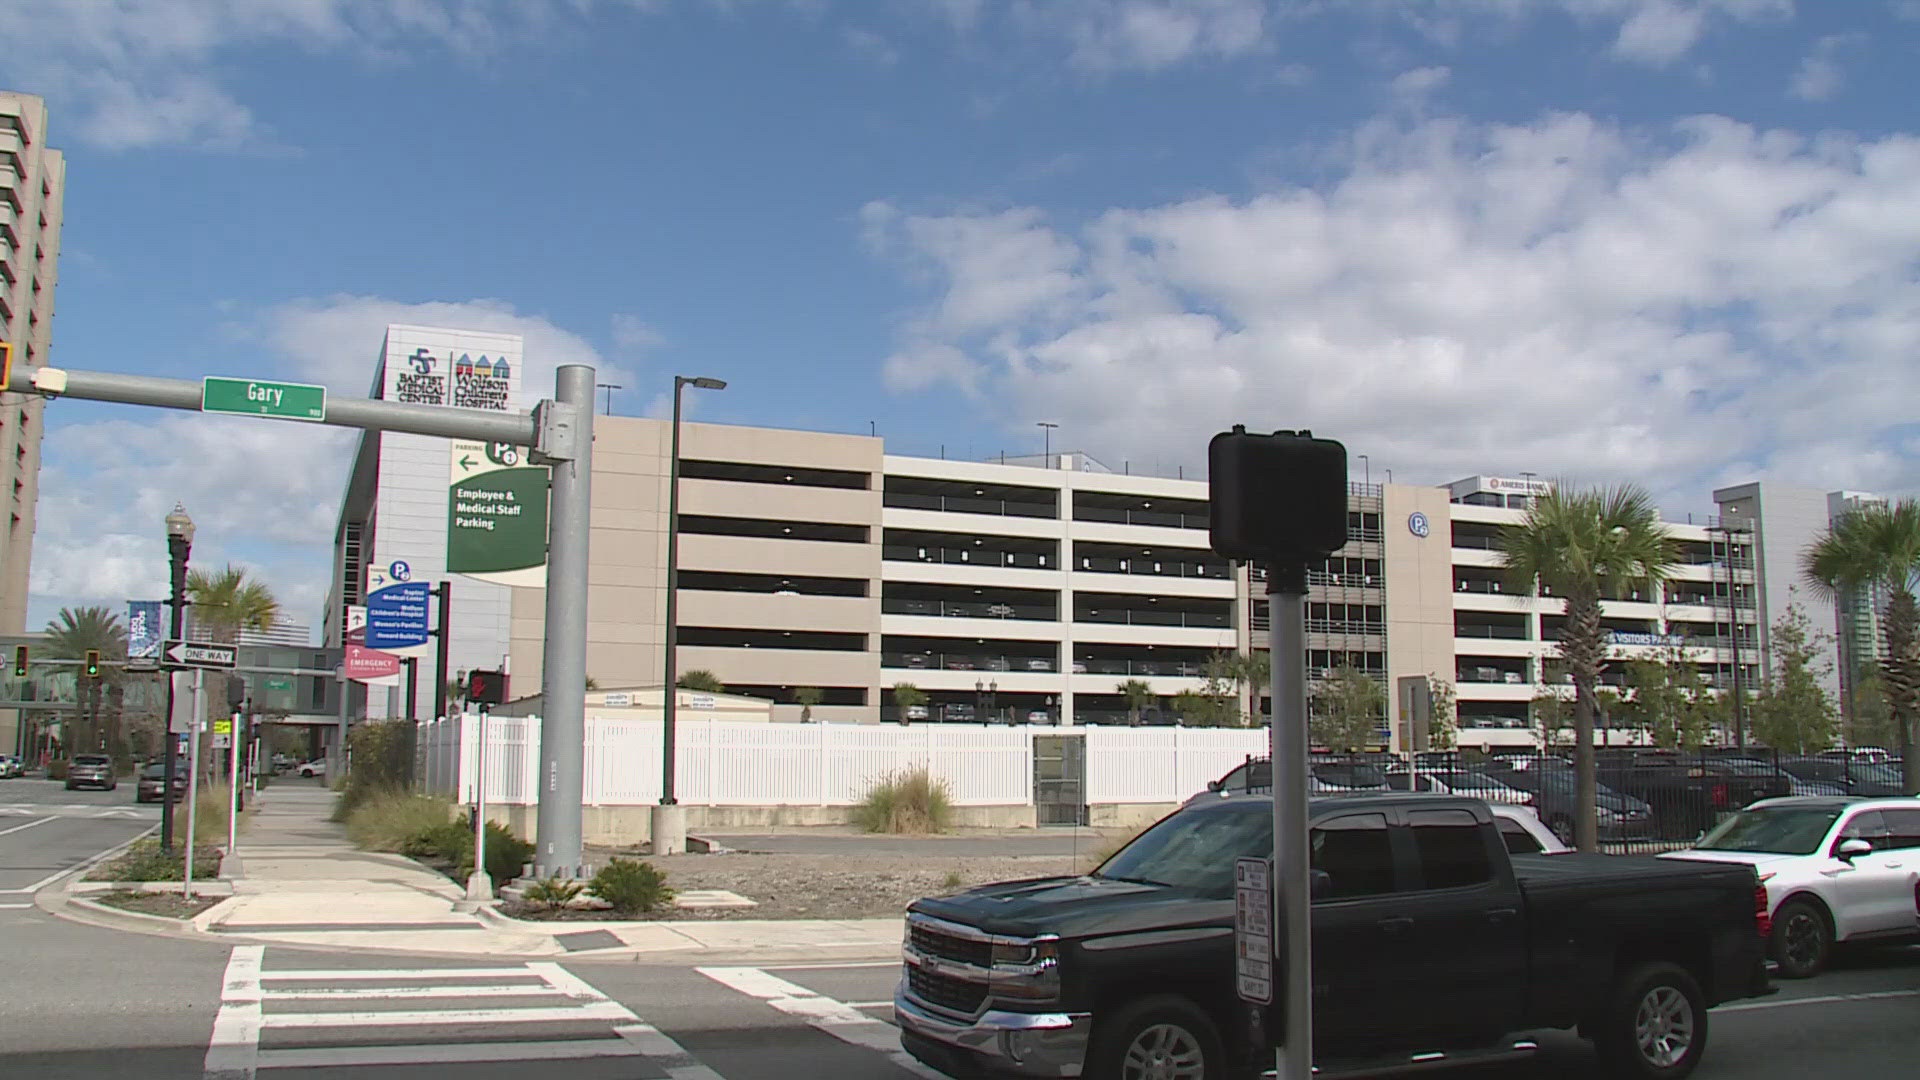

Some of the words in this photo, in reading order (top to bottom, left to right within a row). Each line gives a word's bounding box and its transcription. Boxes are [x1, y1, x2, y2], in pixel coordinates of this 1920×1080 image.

[399, 373, 445, 386] BAPTIST
[455, 373, 509, 390] Wolfson
[247, 383, 283, 407] Gary
[396, 383, 446, 395] MEDICAL
[398, 393, 443, 405] CENTER
[454, 398, 507, 410] HOSPITAL
[457, 488, 505, 502] Employee
[506, 491, 514, 501] &
[457, 503, 495, 514] Medical
[497, 505, 521, 515] Staff
[456, 518, 494, 530] Parking
[1616, 633, 1651, 644] VISITORS
[185, 649, 204, 658] ONE
[208, 650, 230, 660] WAY
[350, 659, 393, 667] EMERGENCY
